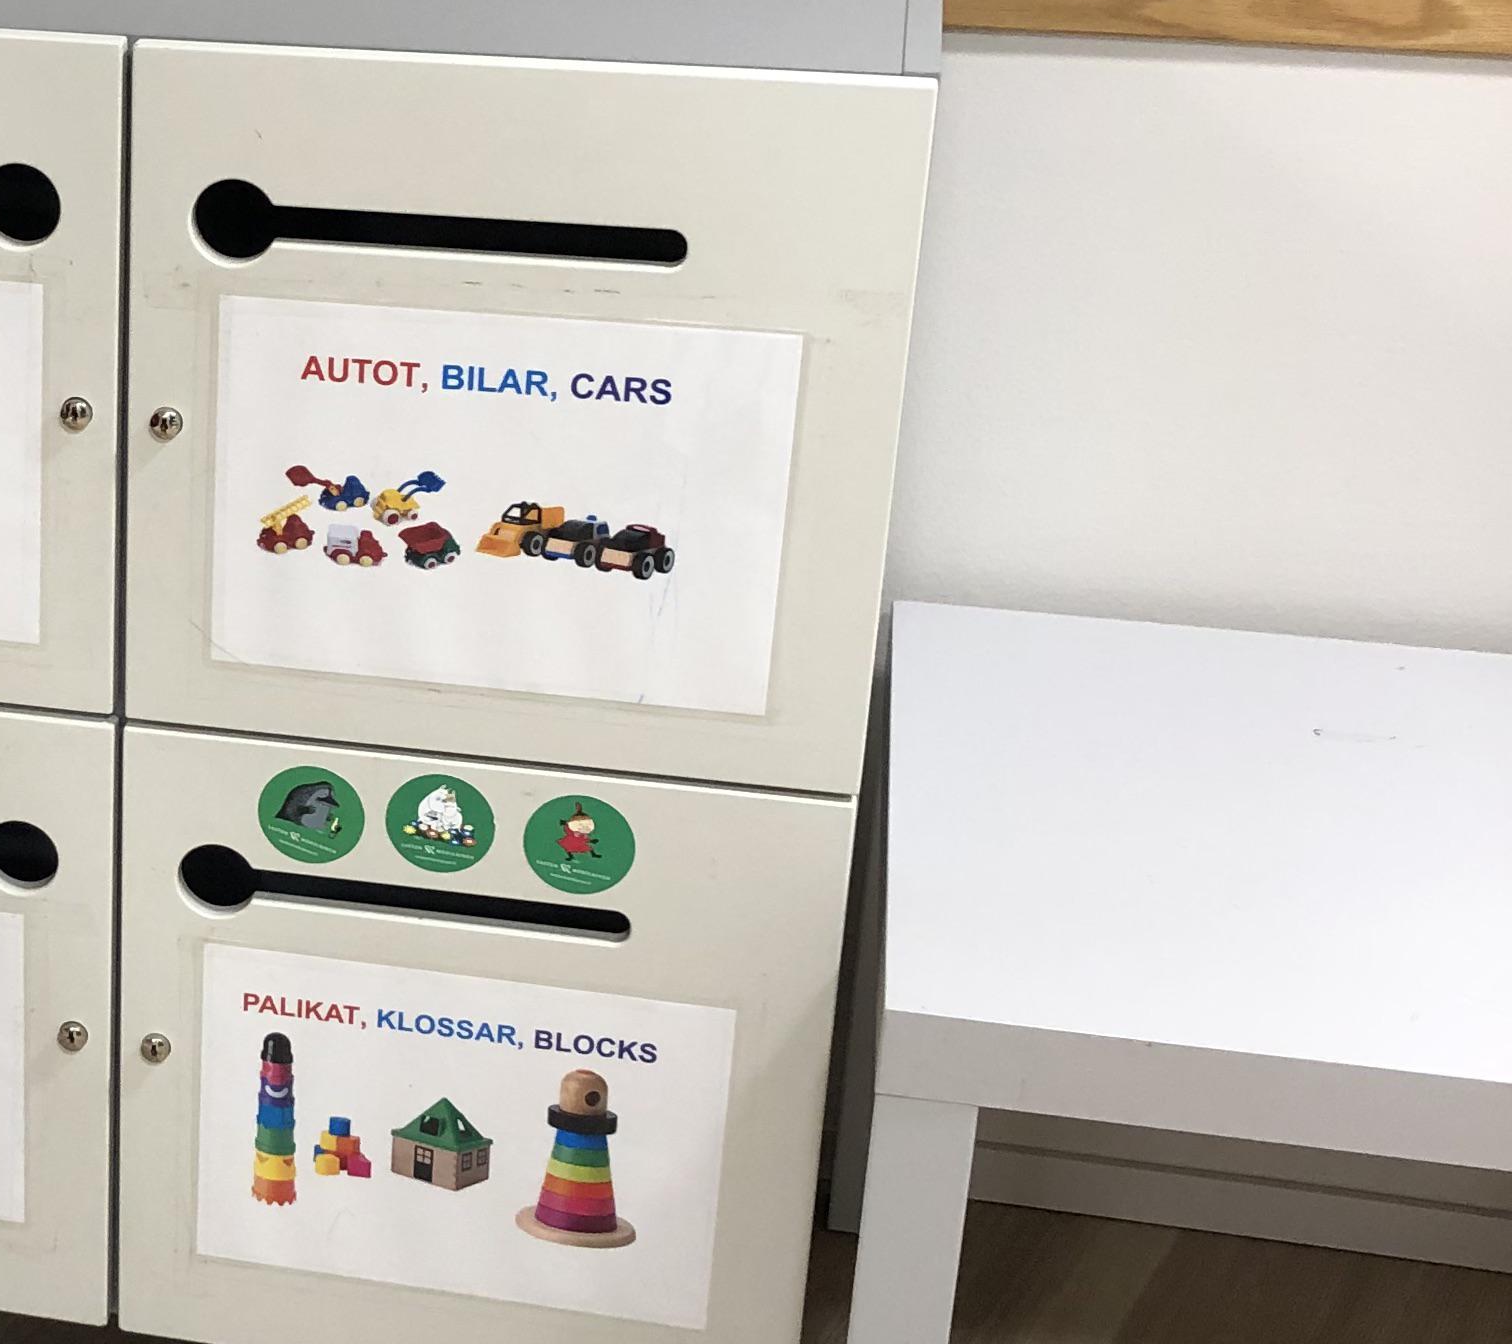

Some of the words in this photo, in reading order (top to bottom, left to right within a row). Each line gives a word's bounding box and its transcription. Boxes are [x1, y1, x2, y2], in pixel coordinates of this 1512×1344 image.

[300, 355, 428, 394] AUTOT,
[441, 364, 557, 402] BILAR,
[570, 373, 672, 406] CARS
[243, 992, 367, 1030] PALIKAT,
[377, 1008, 524, 1050] KLOSSAR,
[534, 1029, 658, 1064] BLOCKS
